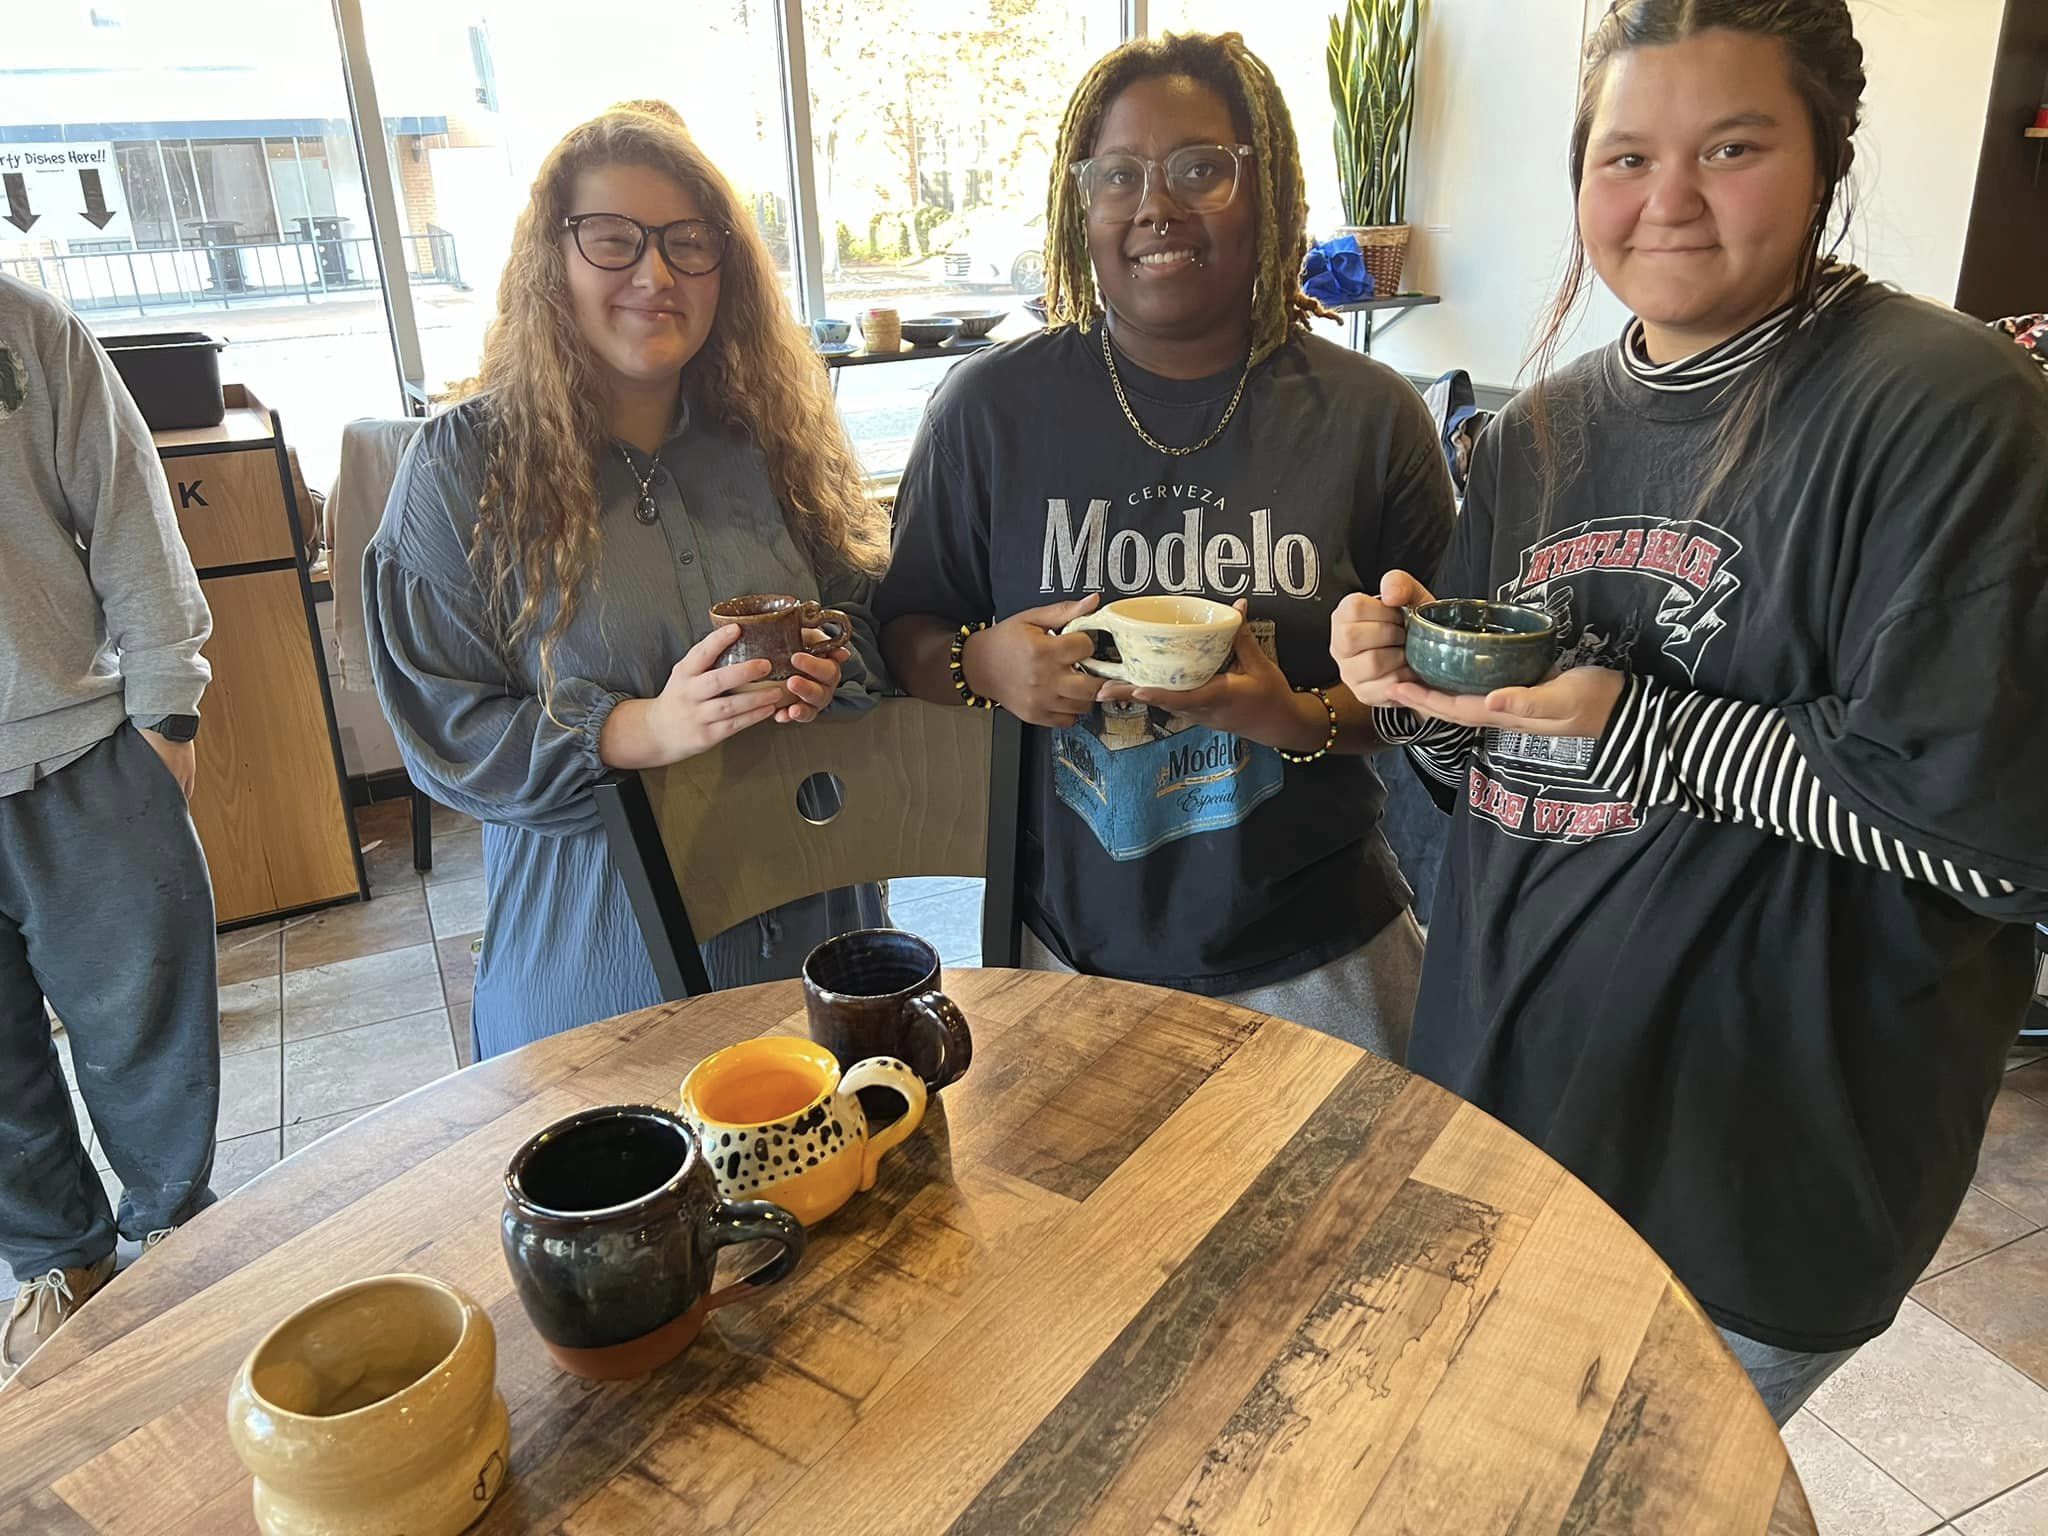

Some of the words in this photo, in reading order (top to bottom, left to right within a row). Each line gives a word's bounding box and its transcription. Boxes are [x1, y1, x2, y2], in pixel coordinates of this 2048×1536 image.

[24, 152, 66, 165] Dishes
[68, 149, 106, 164] Here!!
[178, 480, 208, 509] K
[1128, 484, 1226, 511] CERVEZA
[1039, 498, 1320, 600] Modelo
[1521, 529, 1645, 588] MYRTLE
[1168, 732, 1243, 781] Modelo
